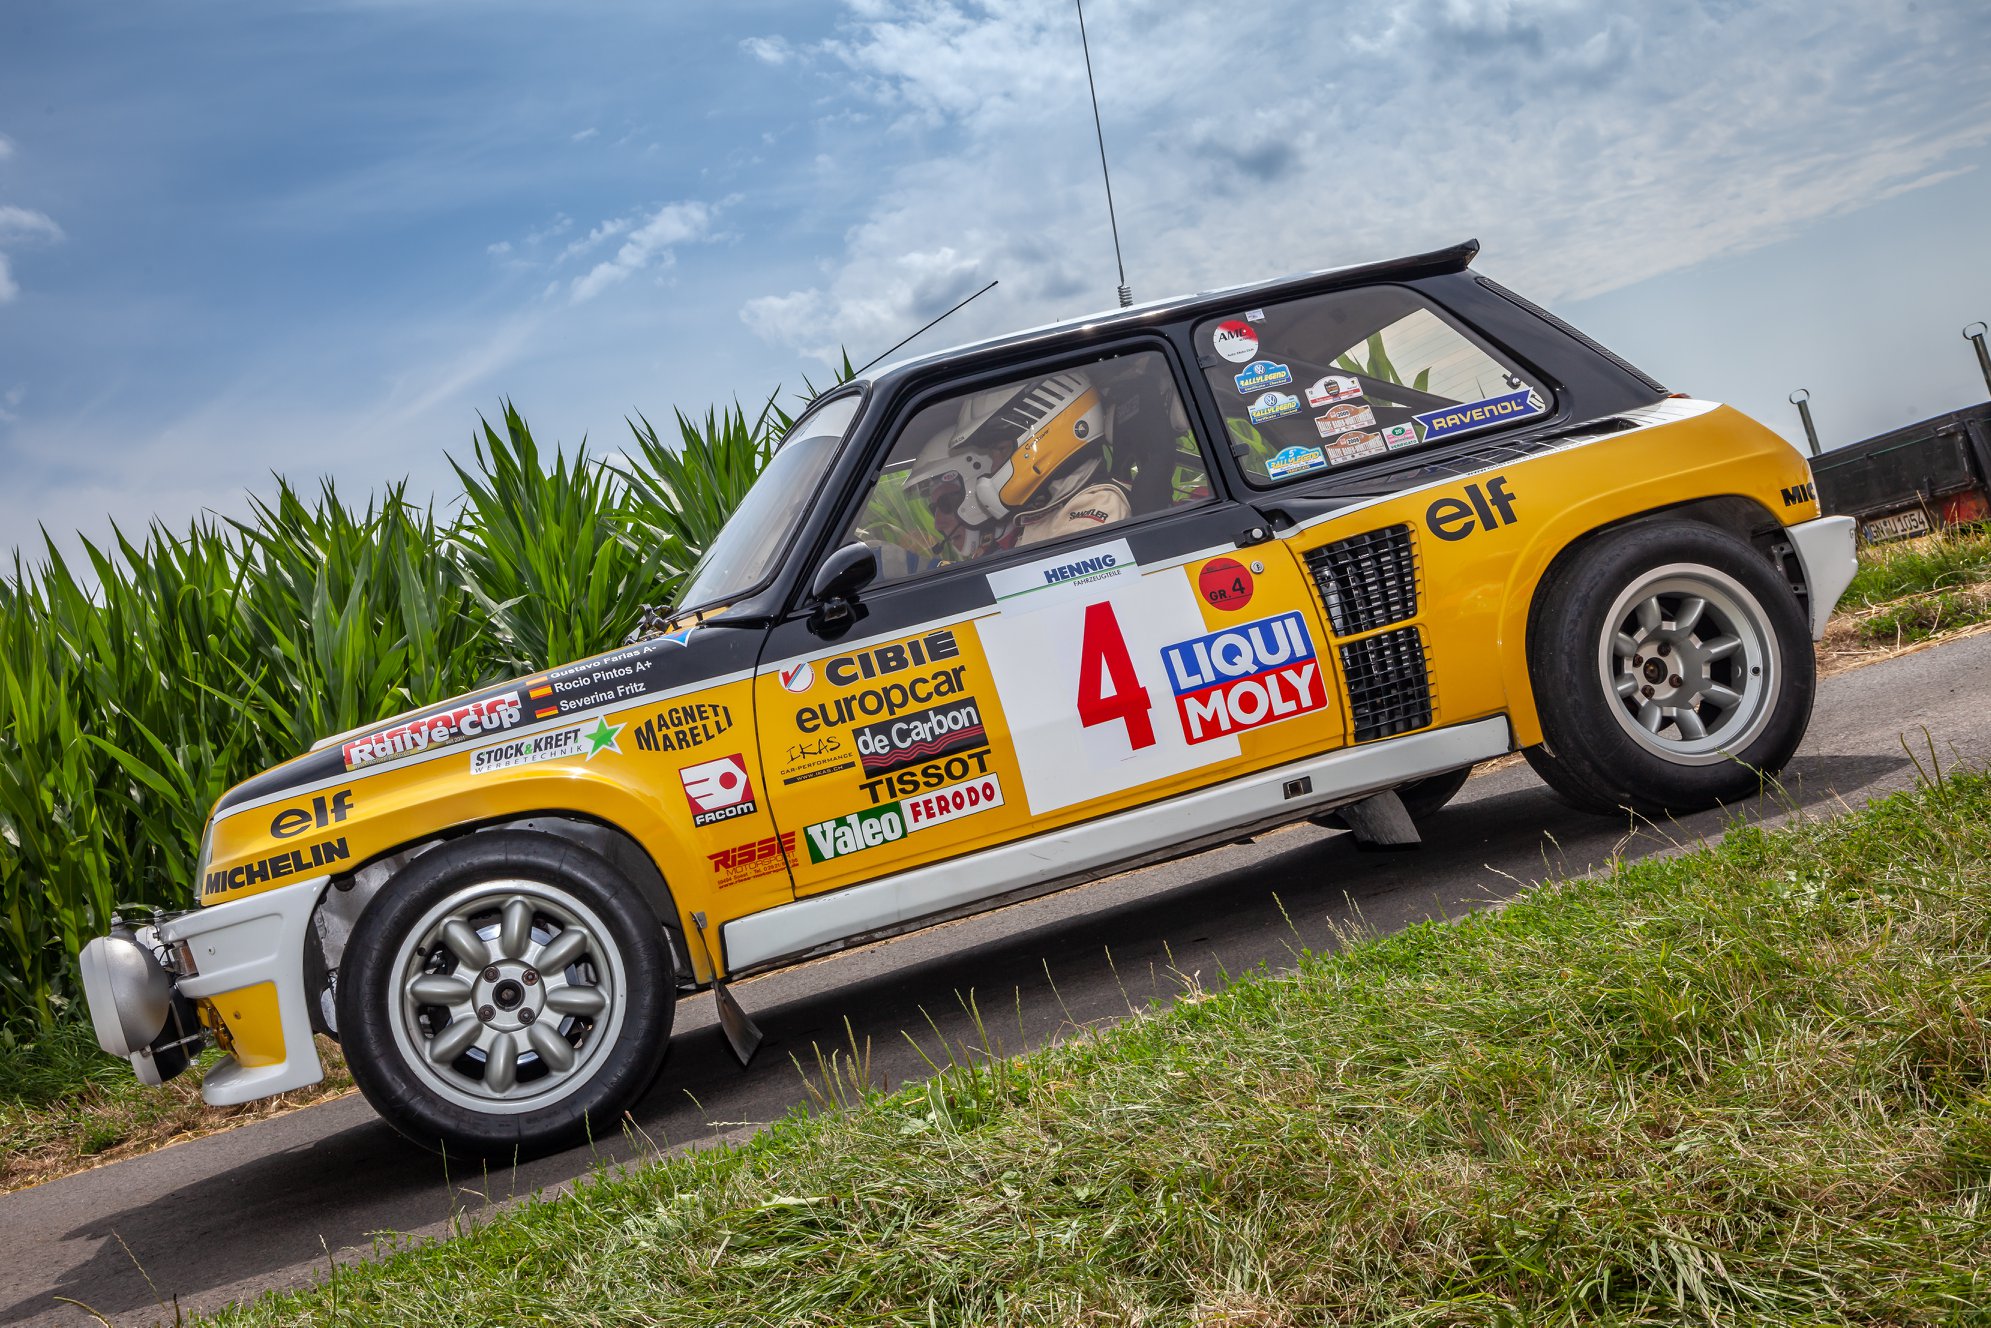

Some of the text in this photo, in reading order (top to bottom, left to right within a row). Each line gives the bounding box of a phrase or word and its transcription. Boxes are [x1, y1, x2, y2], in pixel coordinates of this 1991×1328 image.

[1432, 400, 1524, 431] RAVENOL
[1426, 475, 1518, 542] elf
[1898, 510, 1926, 533] 1054
[1043, 554, 1117, 584] HENNIG
[1073, 569, 1122, 587] FAHRZEUGTEILE
[1209, 577, 1246, 601] GR. 4
[550, 660, 601, 680] Gustavo
[825, 630, 960, 687] CIBIÉ
[1168, 616, 1307, 690] LIQUI
[554, 659, 653, 694] Rocio Pintos A+
[559, 681, 647, 713] Severina Fritz
[796, 663, 967, 734] europcar
[1077, 601, 1156, 751] 4
[1184, 664, 1316, 740] MOLY
[350, 705, 522, 766] Rallye-Cup
[475, 728, 582, 767] STOCK&KREFT
[634, 703, 734, 748] MAGNETI
[634, 716, 734, 752] MARELLI
[856, 703, 981, 756] de Carbon
[474, 744, 583, 774] WERBETECHNIK
[787, 735, 841, 765] IKAS
[859, 749, 992, 806] TISSOT
[270, 789, 355, 840] elf
[695, 802, 755, 826] FACOM
[910, 779, 997, 825] FERODO
[808, 803, 904, 863] Valeo
[204, 837, 351, 896] MICHELIN
